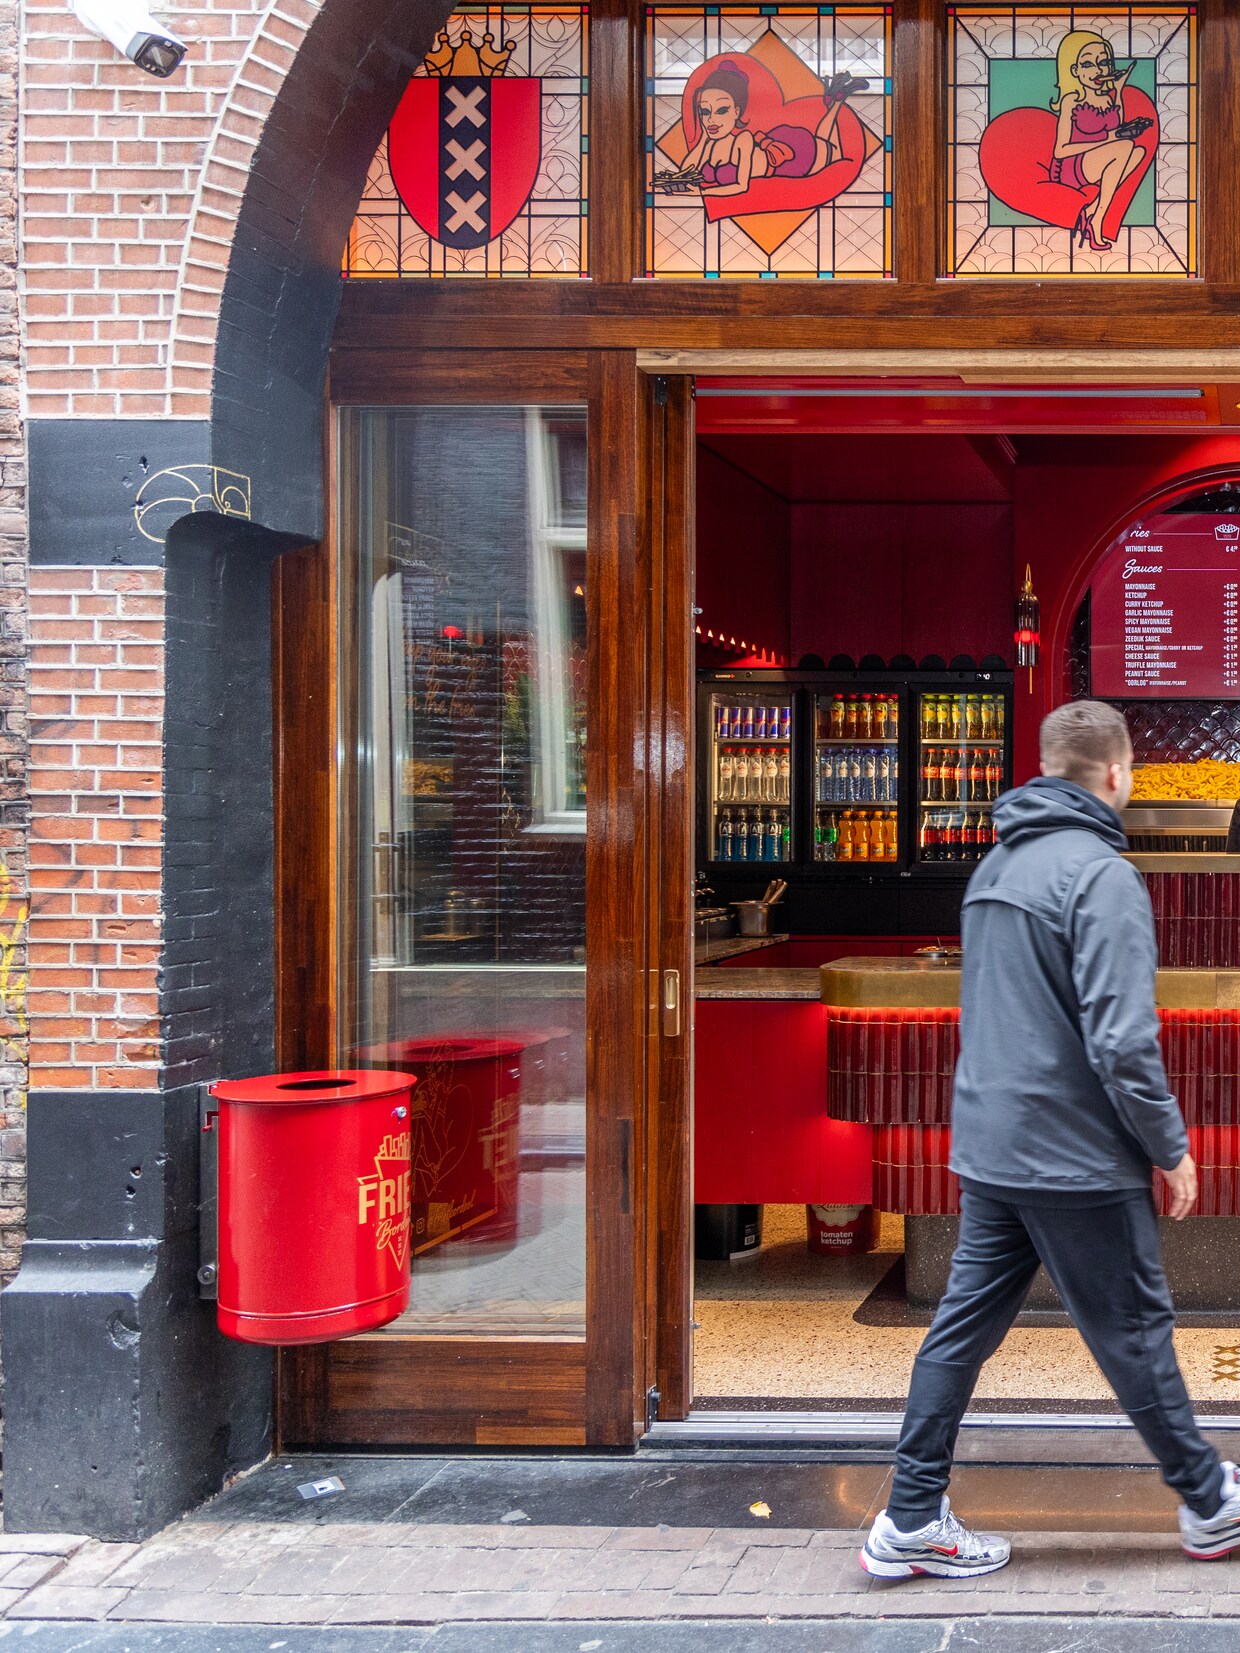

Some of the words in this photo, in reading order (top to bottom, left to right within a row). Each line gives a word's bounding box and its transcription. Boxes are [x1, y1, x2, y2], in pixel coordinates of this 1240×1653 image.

[1130, 526, 1150, 538] ries
[1122, 559, 1163, 579] Sauces
[359, 1169, 411, 1224] FRIE
[820, 1237, 853, 1246] ketchup
